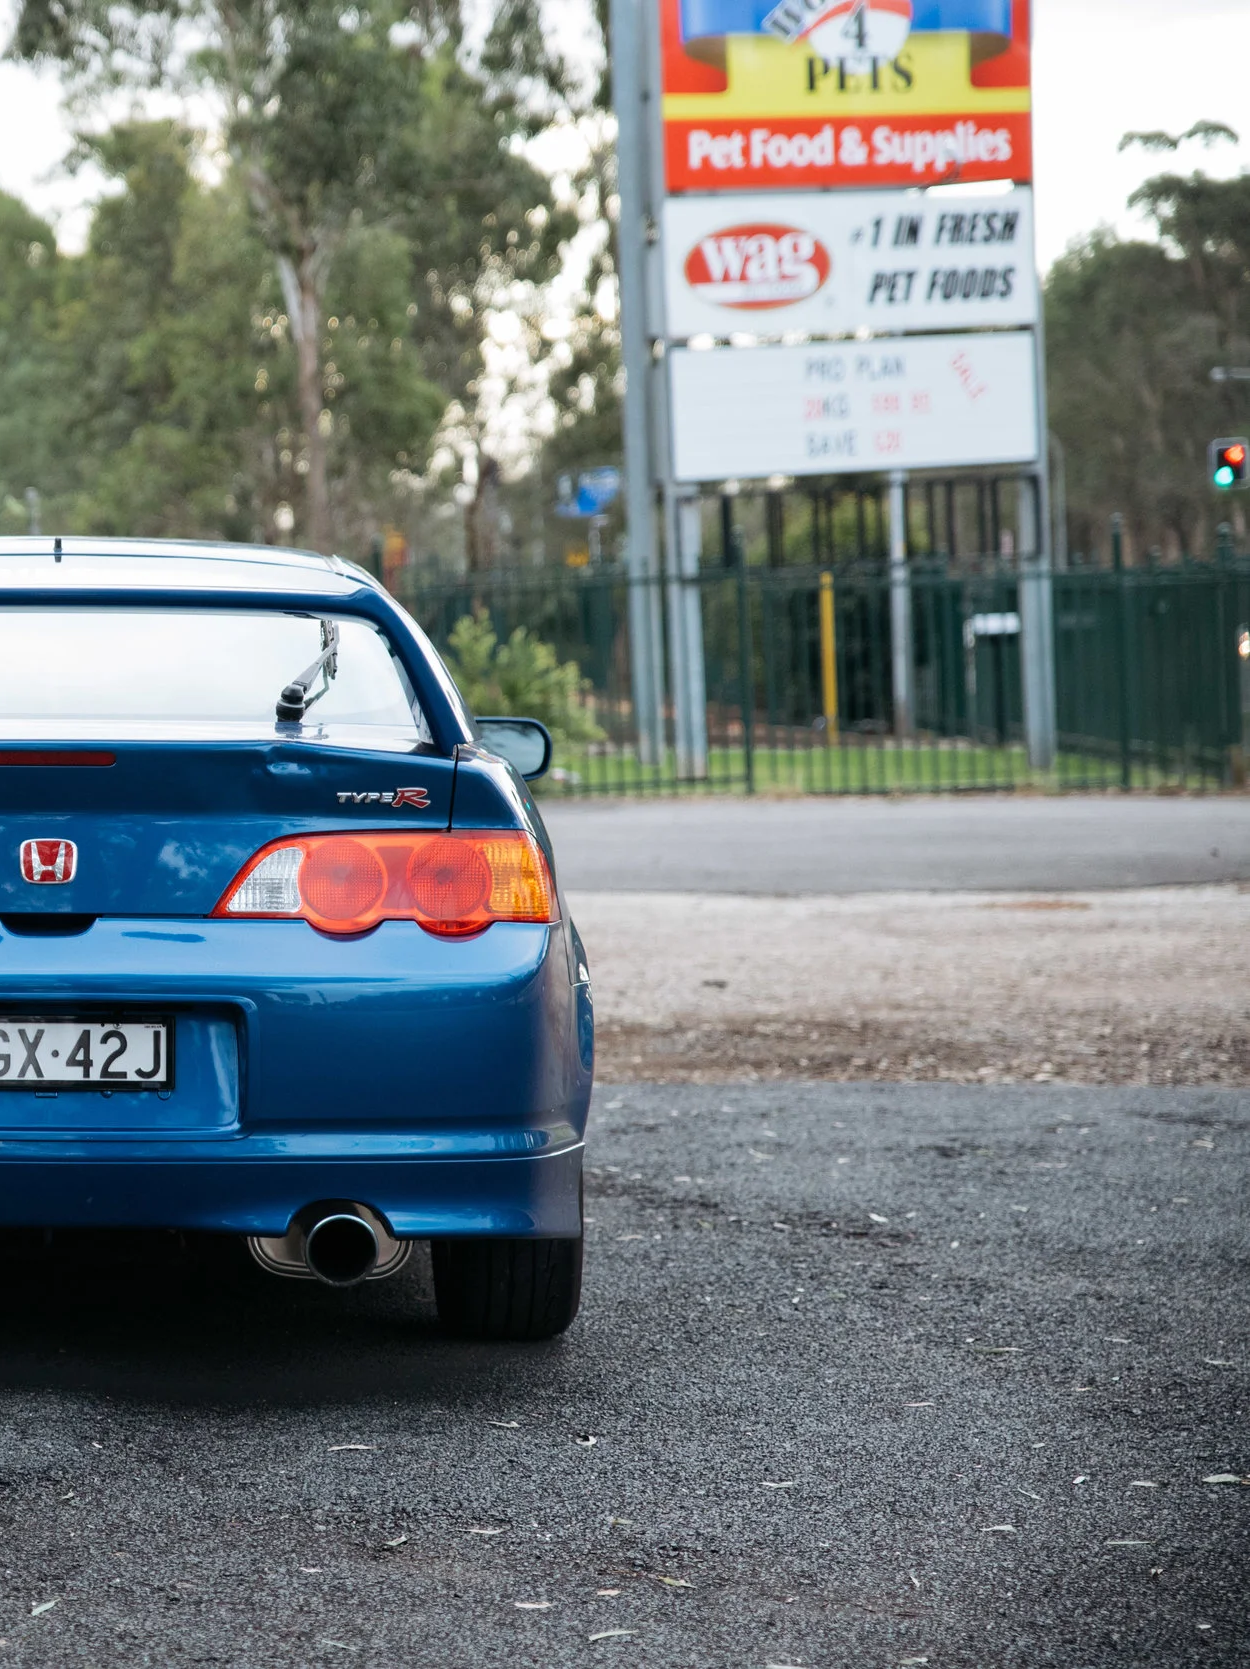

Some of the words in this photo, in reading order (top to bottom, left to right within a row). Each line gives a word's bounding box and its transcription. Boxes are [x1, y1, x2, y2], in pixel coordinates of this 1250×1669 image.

[839, 3, 867, 48] 4
[806, 53, 914, 93] PETS
[688, 130, 746, 169] Pet
[750, 124, 835, 168] Food
[839, 126, 870, 166] &
[871, 121, 1012, 172] Supplies
[893, 214, 921, 246] IN
[935, 210, 1019, 244] FRESH
[869, 271, 916, 303] PET
[927, 267, 1015, 300] FOODS
